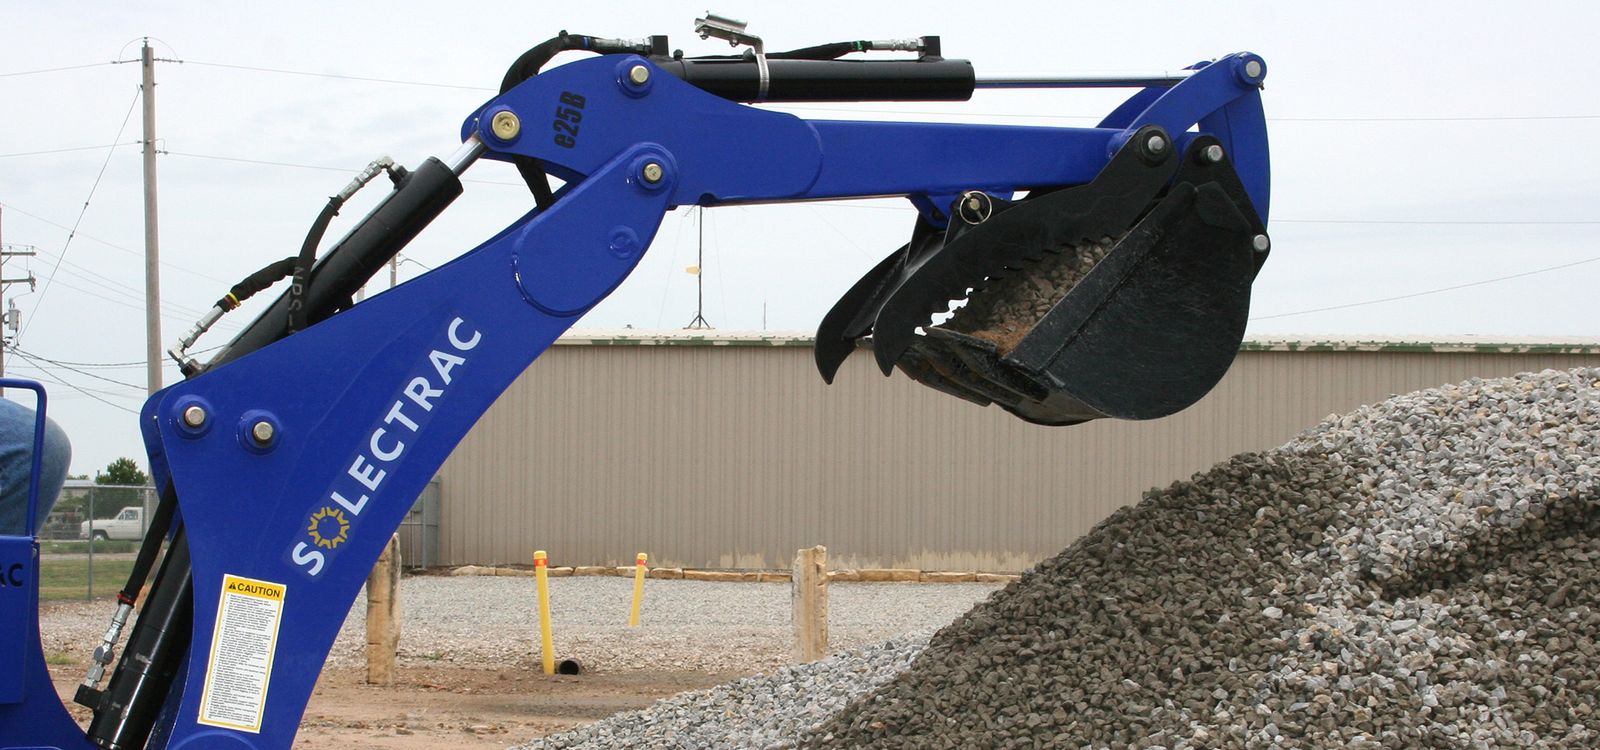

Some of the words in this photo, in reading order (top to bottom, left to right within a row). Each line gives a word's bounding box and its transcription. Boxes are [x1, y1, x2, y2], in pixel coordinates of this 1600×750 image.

[553, 91, 586, 149] e25B
[292, 317, 482, 577] SOLECTRAC
[237, 583, 281, 598] CAUTION
